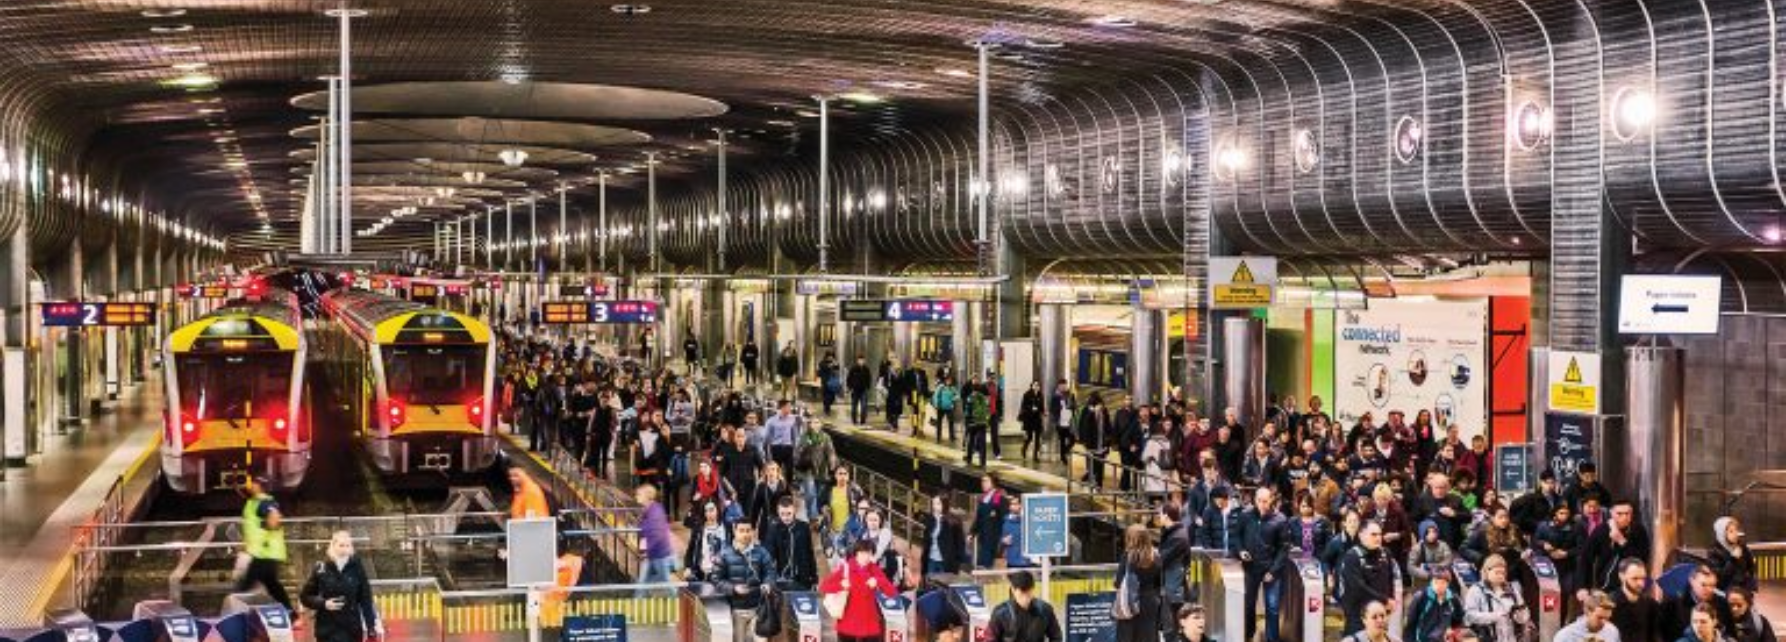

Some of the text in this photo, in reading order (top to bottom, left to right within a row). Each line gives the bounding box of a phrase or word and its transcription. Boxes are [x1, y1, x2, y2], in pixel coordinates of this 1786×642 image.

[83, 304, 98, 324] 2
[594, 302, 608, 322] 3
[887, 302, 902, 320] 4
[1342, 324, 1400, 343] connected
